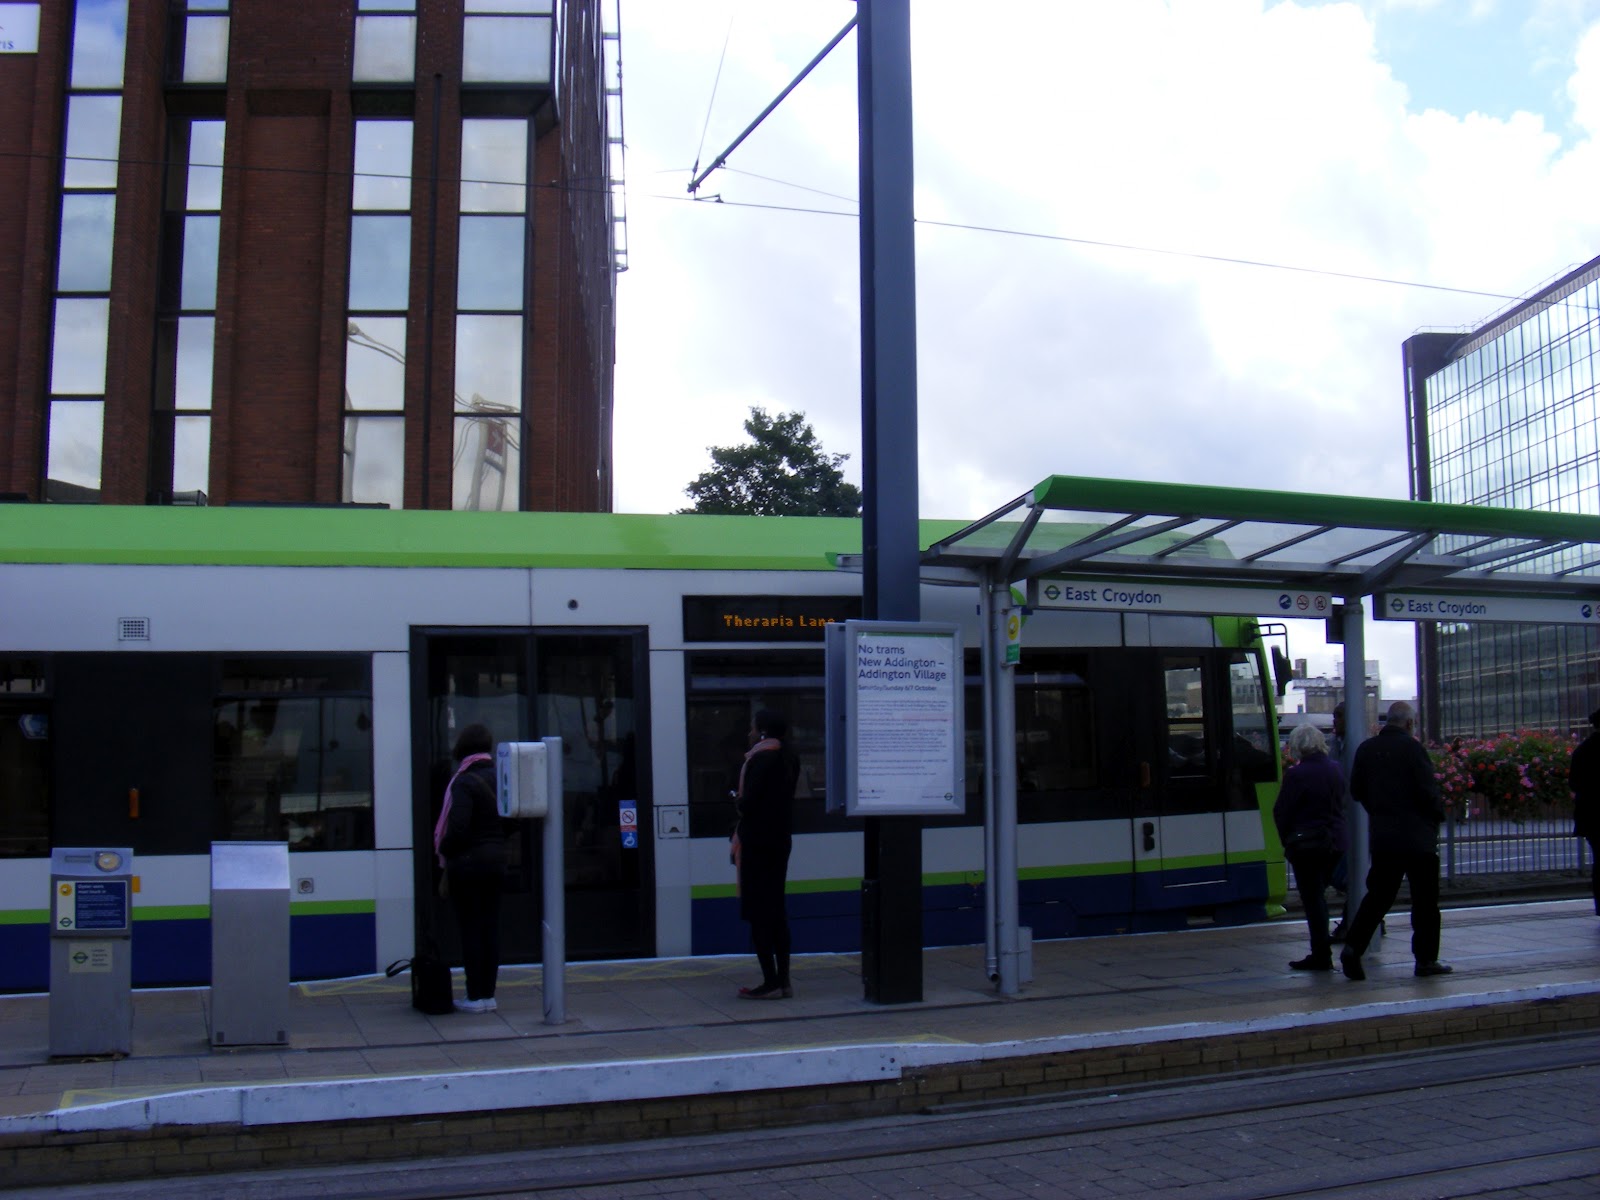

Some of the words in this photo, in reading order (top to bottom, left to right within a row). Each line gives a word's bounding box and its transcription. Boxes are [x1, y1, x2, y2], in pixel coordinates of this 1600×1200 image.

[1065, 586, 1097, 601] East
[1102, 588, 1162, 606] Croydon
[1408, 599, 1434, 613] East
[1438, 601, 1486, 616] Croydon
[723, 614, 794, 627] Therapia
[858, 644, 874, 654] No
[876, 645, 905, 655] trams
[858, 657, 881, 667] New
[884, 657, 936, 670] Addington
[858, 669, 911, 681] Addington
[913, 670, 947, 682] Village
